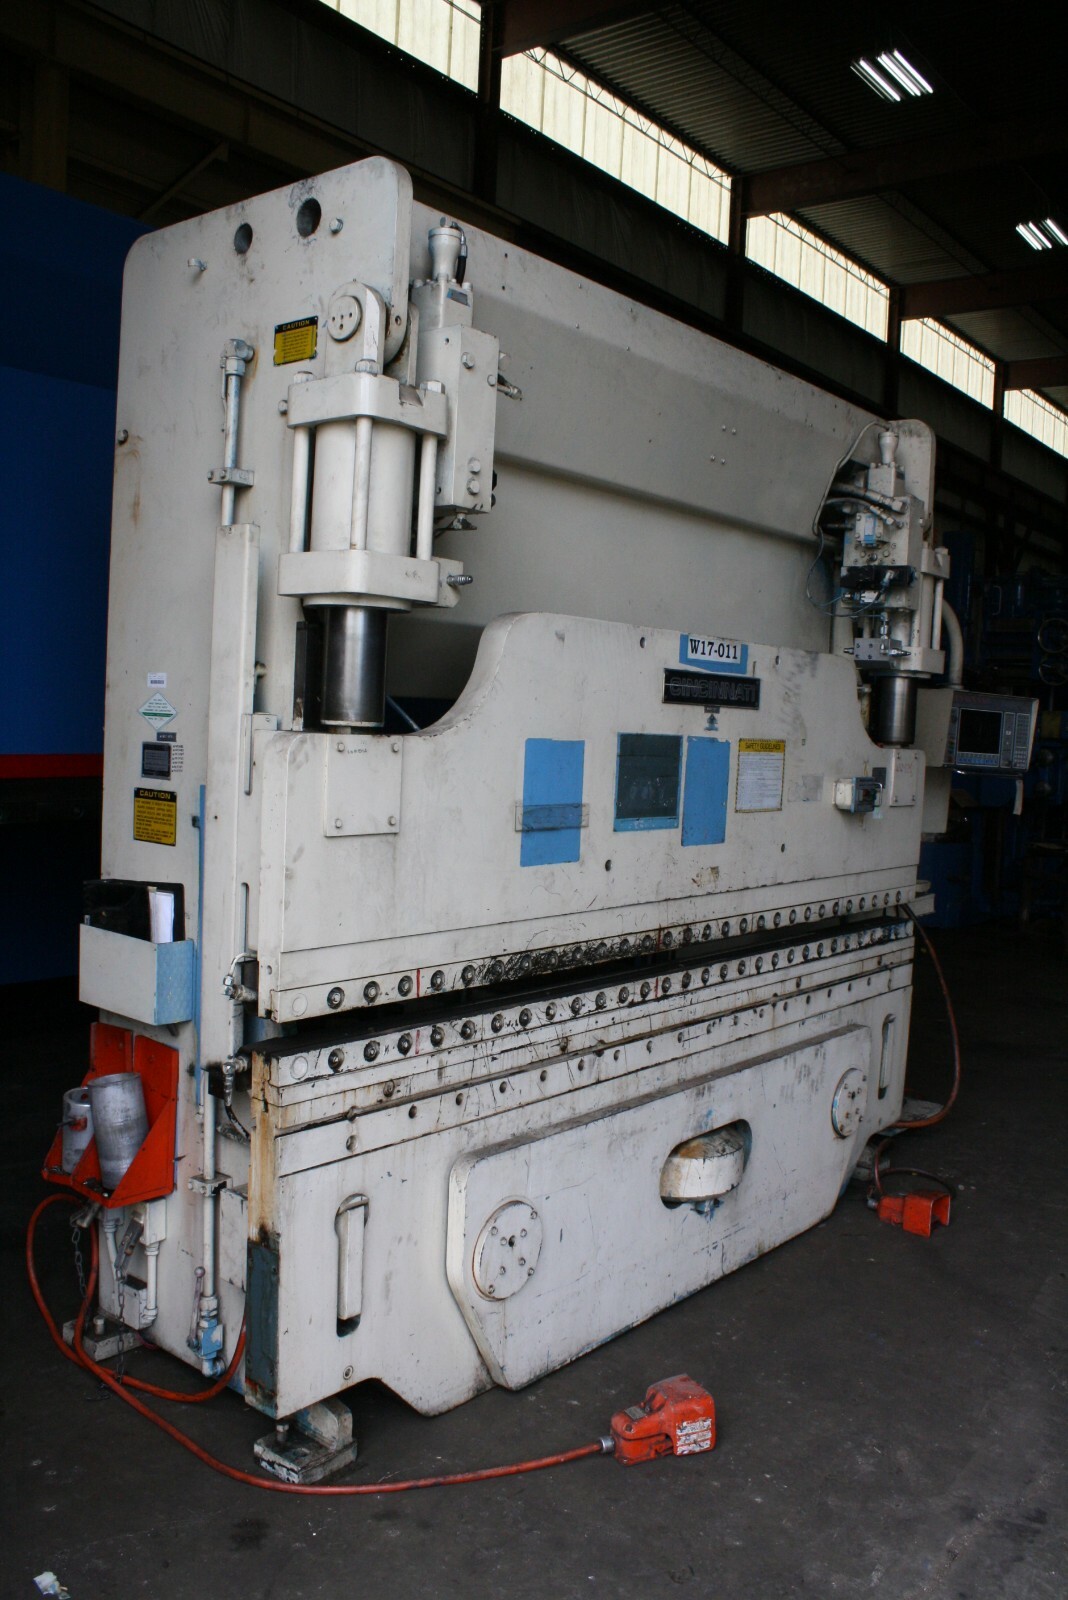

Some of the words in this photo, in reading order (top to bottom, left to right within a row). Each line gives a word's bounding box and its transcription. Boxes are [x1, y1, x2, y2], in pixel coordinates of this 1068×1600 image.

[282, 320, 310, 331] CAUTION
[689, 638, 738, 660] W17-011
[669, 676, 756, 702] CINCINNATI
[139, 789, 171, 800] CAUTION
